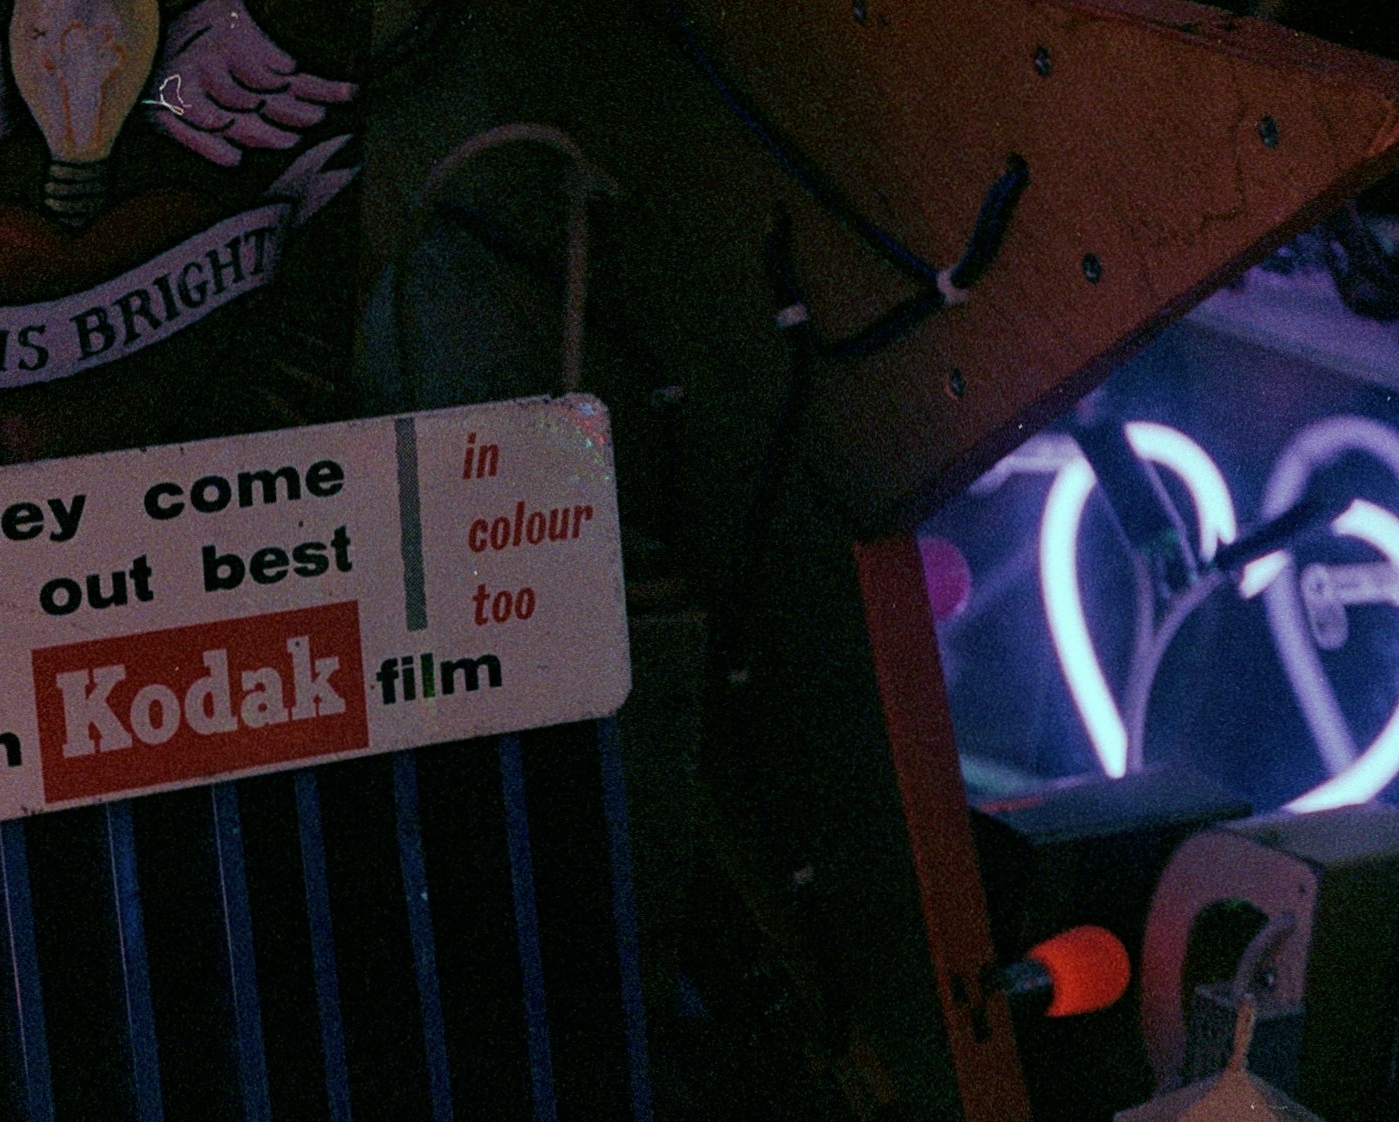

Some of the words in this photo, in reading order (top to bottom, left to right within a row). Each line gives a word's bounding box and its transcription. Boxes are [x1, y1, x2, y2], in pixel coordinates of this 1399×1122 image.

[69, 226, 277, 361] BRIGHT
[462, 432, 500, 480] in
[144, 460, 345, 520] come
[468, 501, 594, 553] colour
[39, 554, 154, 616] out
[202, 525, 353, 593] best
[472, 583, 537, 626] too
[55, 634, 347, 760] Kodak
[376, 652, 503, 705] film
